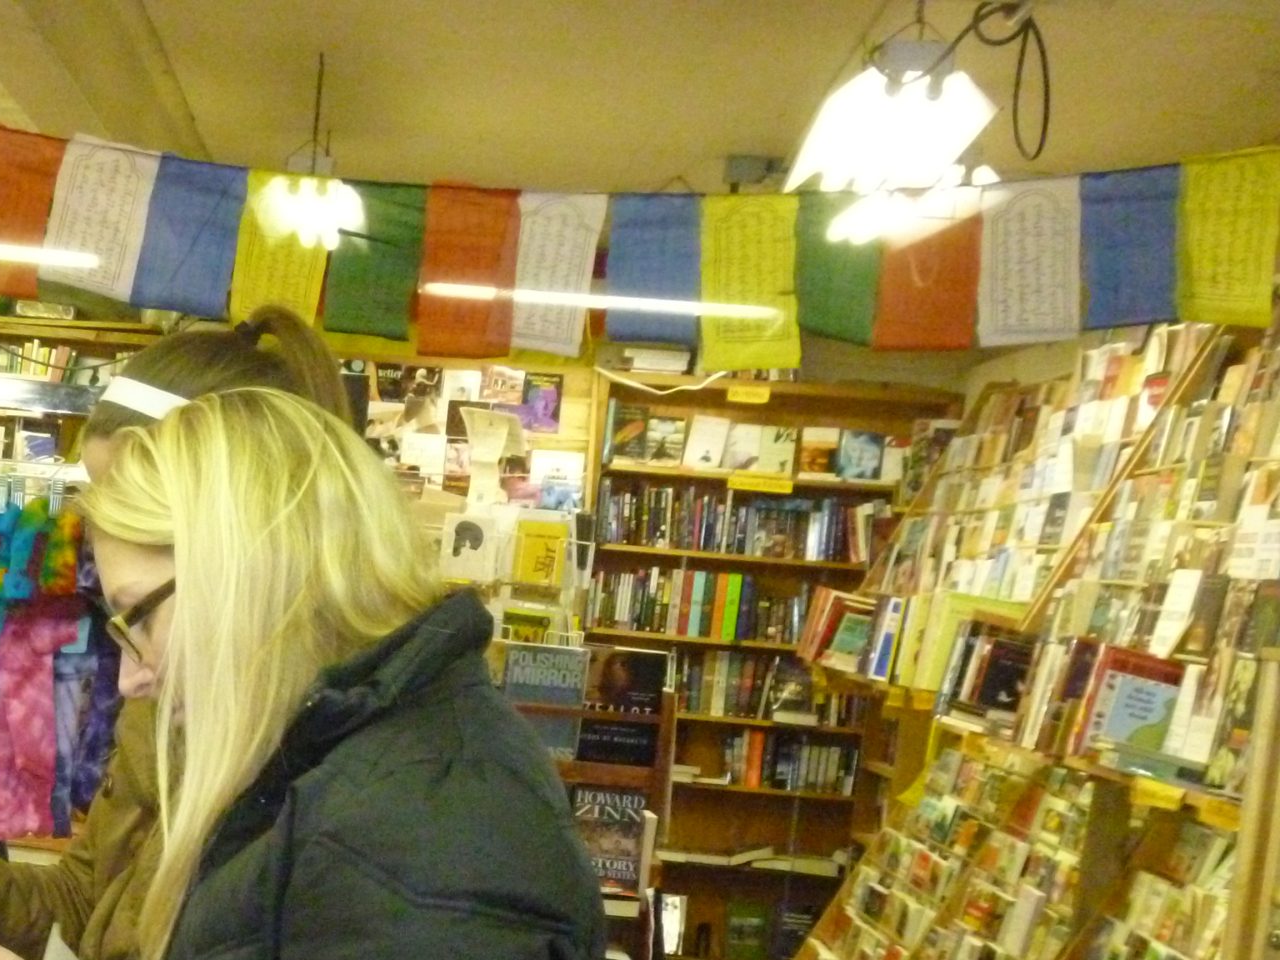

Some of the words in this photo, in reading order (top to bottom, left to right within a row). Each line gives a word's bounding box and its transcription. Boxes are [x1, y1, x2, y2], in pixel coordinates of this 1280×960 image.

[510, 650, 583, 667] POLISHING
[512, 666, 582, 688] MIRROR
[577, 789, 646, 809] HOWARD
[575, 804, 641, 823] ZINN
